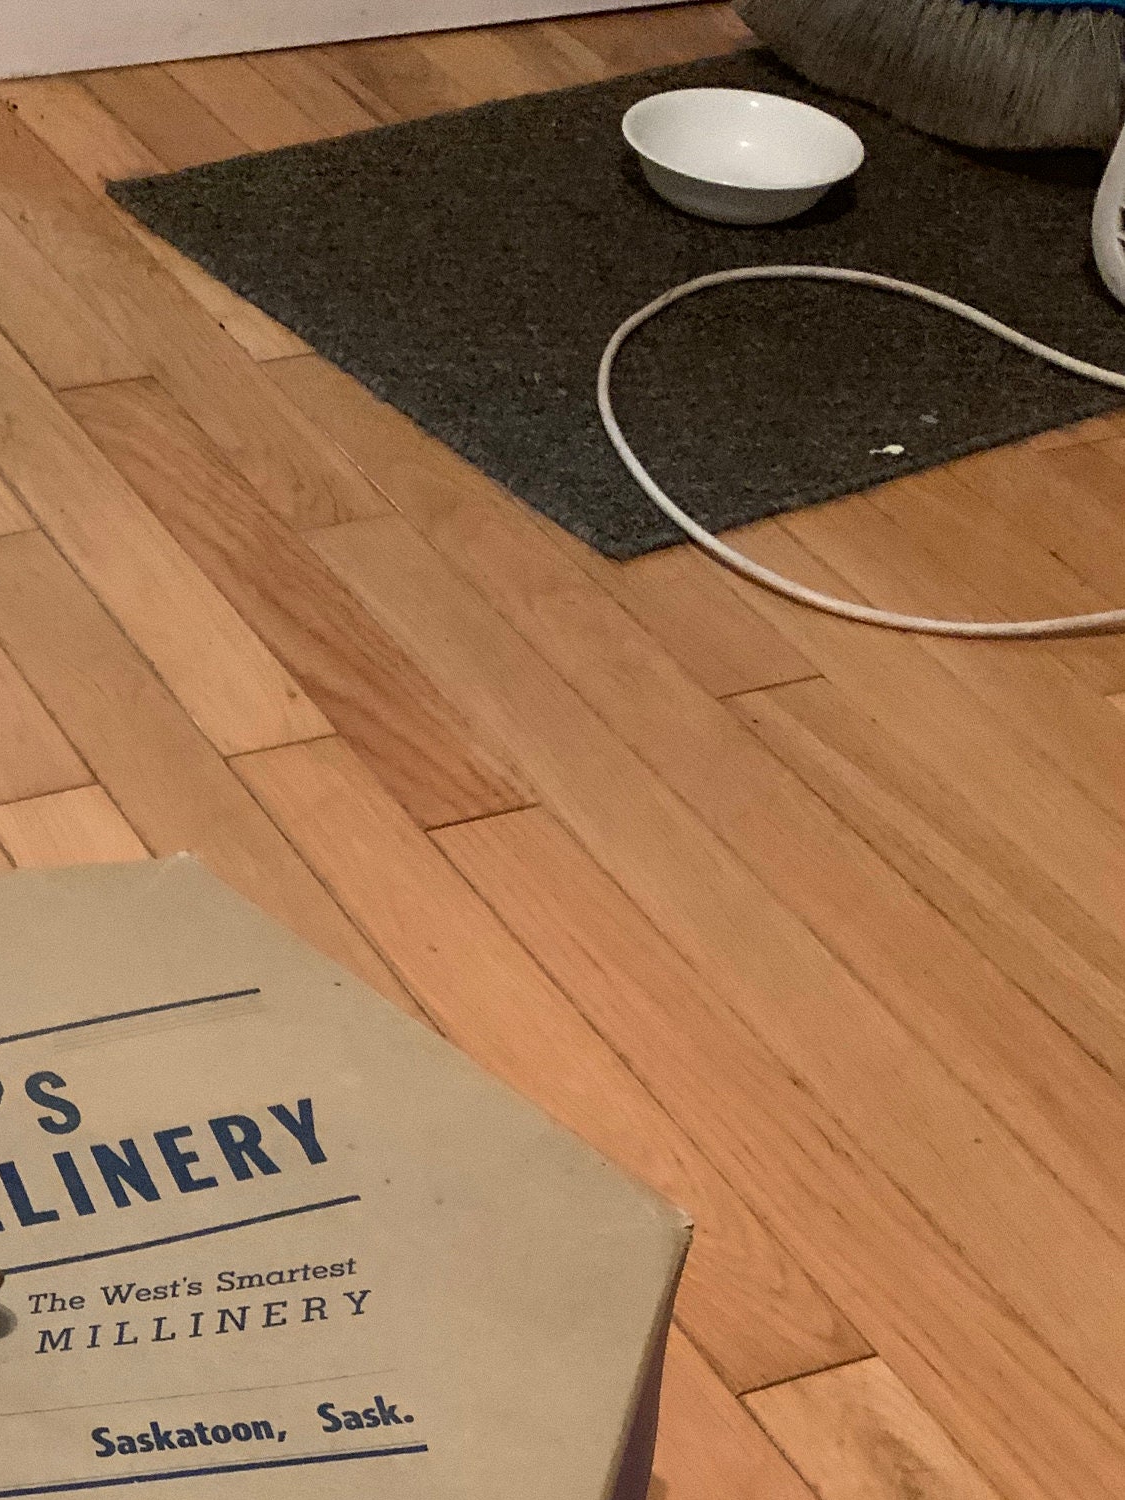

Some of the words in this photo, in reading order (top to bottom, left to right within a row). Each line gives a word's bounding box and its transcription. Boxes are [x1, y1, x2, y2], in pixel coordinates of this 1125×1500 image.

[28, 1293, 86, 1315] The
[100, 1277, 203, 1306] West's
[216, 1257, 357, 1293] Smartest
[34, 1289, 372, 1354] MILLINERY
[91, 1419, 287, 1457] Saskatoon,
[317, 1395, 414, 1432] Sask.
